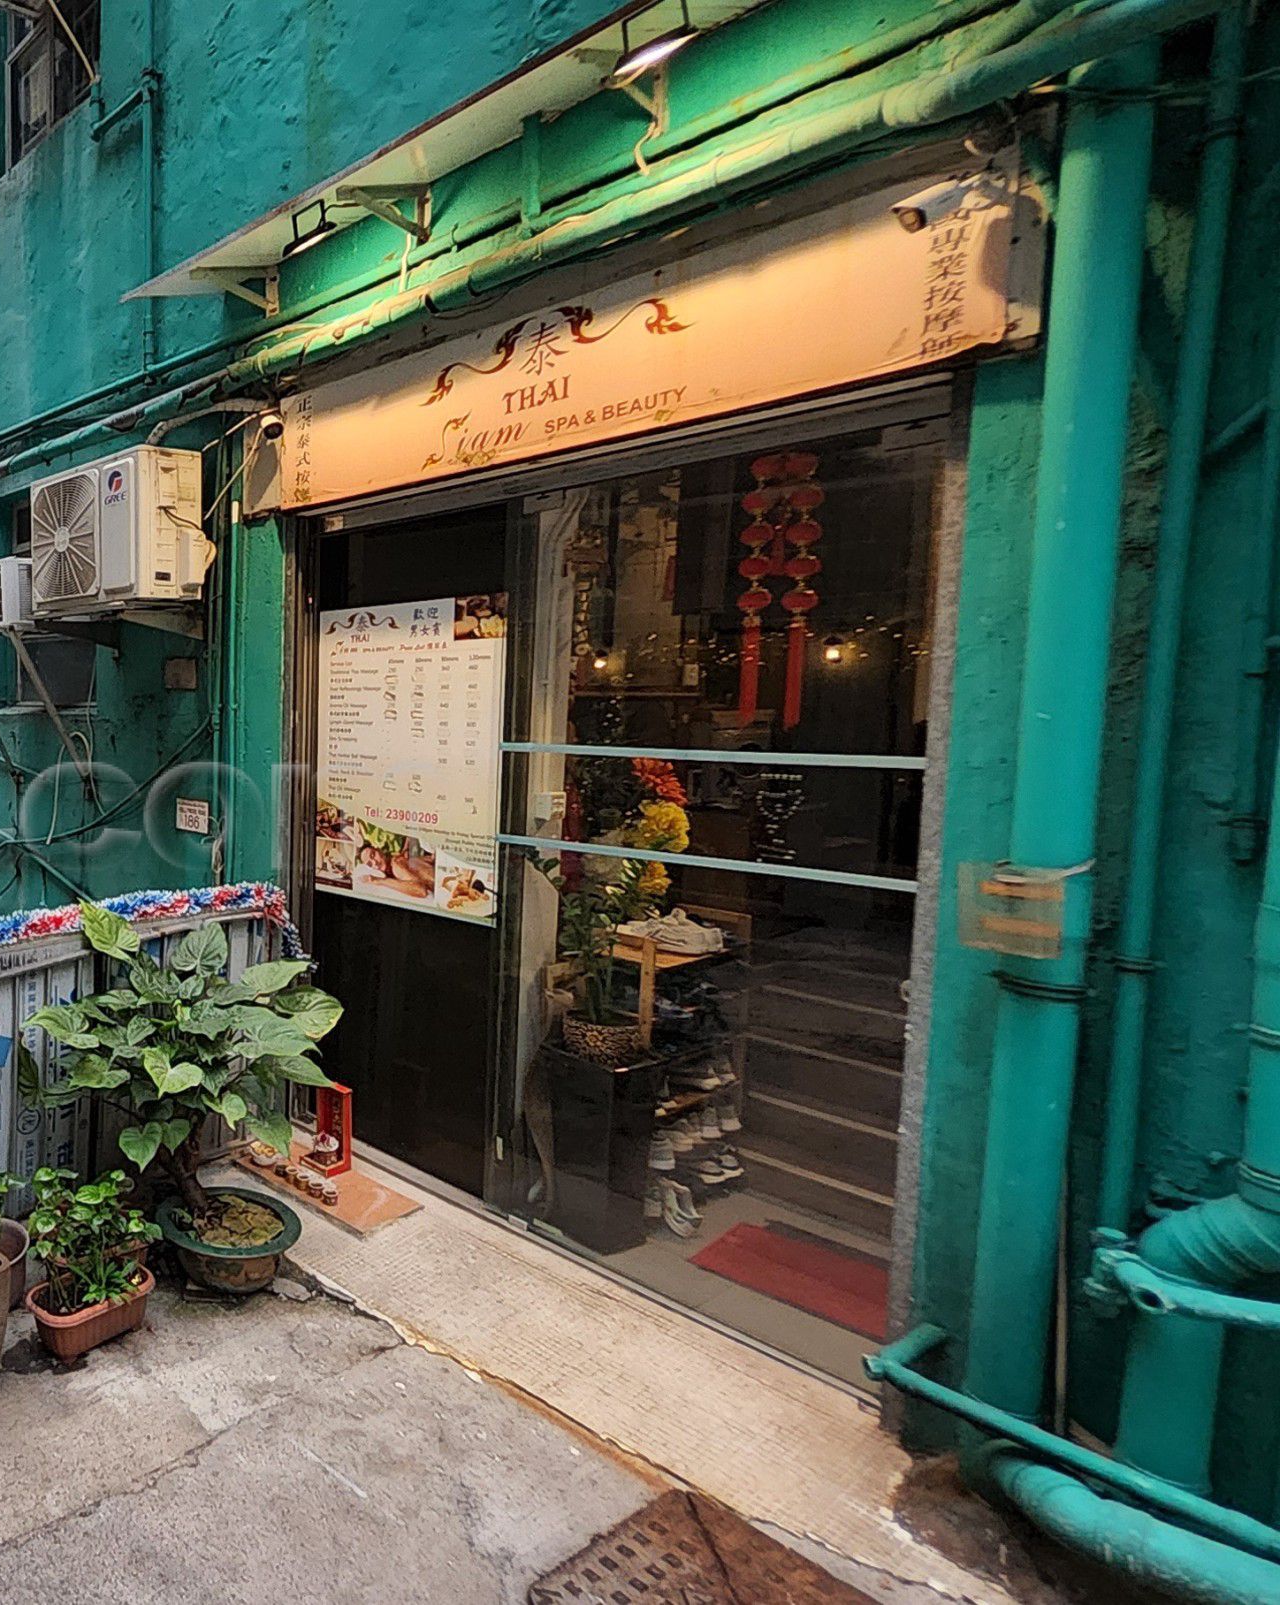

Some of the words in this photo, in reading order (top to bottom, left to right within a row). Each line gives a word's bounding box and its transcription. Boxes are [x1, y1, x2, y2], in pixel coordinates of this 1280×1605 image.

[921, 212, 970, 357] 專業按摩師
[520, 322, 570, 375] 泰
[502, 375, 571, 416] THAI
[422, 409, 532, 471] Siam
[544, 416, 579, 434] SPA
[585, 413, 596, 424] &
[601, 386, 687, 422] BEAUTY
[104, 491, 127, 505] GREE
[351, 634, 369, 644] THAI
[386, 809, 438, 824] 23900209
